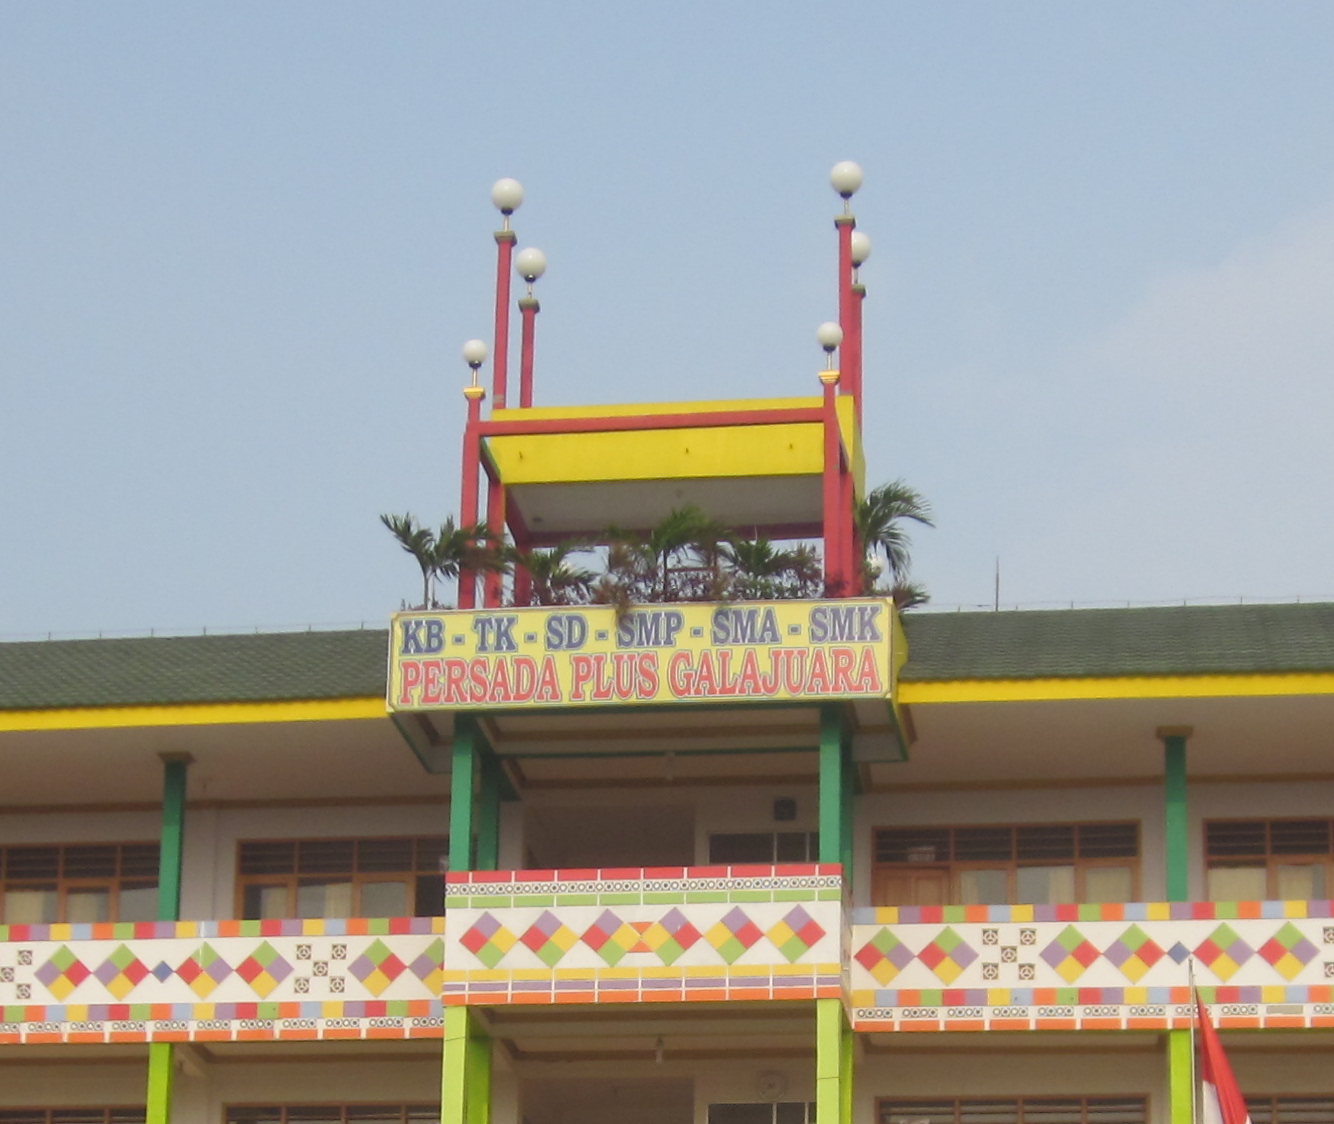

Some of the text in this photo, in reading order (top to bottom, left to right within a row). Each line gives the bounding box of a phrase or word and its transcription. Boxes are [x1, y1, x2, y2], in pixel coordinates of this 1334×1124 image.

[400, 618, 445, 654] KB
[473, 615, 517, 652] TK
[545, 614, 588, 650] SD
[616, 609, 683, 648] SMP
[712, 607, 782, 645] SMA
[810, 604, 883, 643] SMK
[399, 646, 883, 705] PERSADA PLUS GALAJUARA
